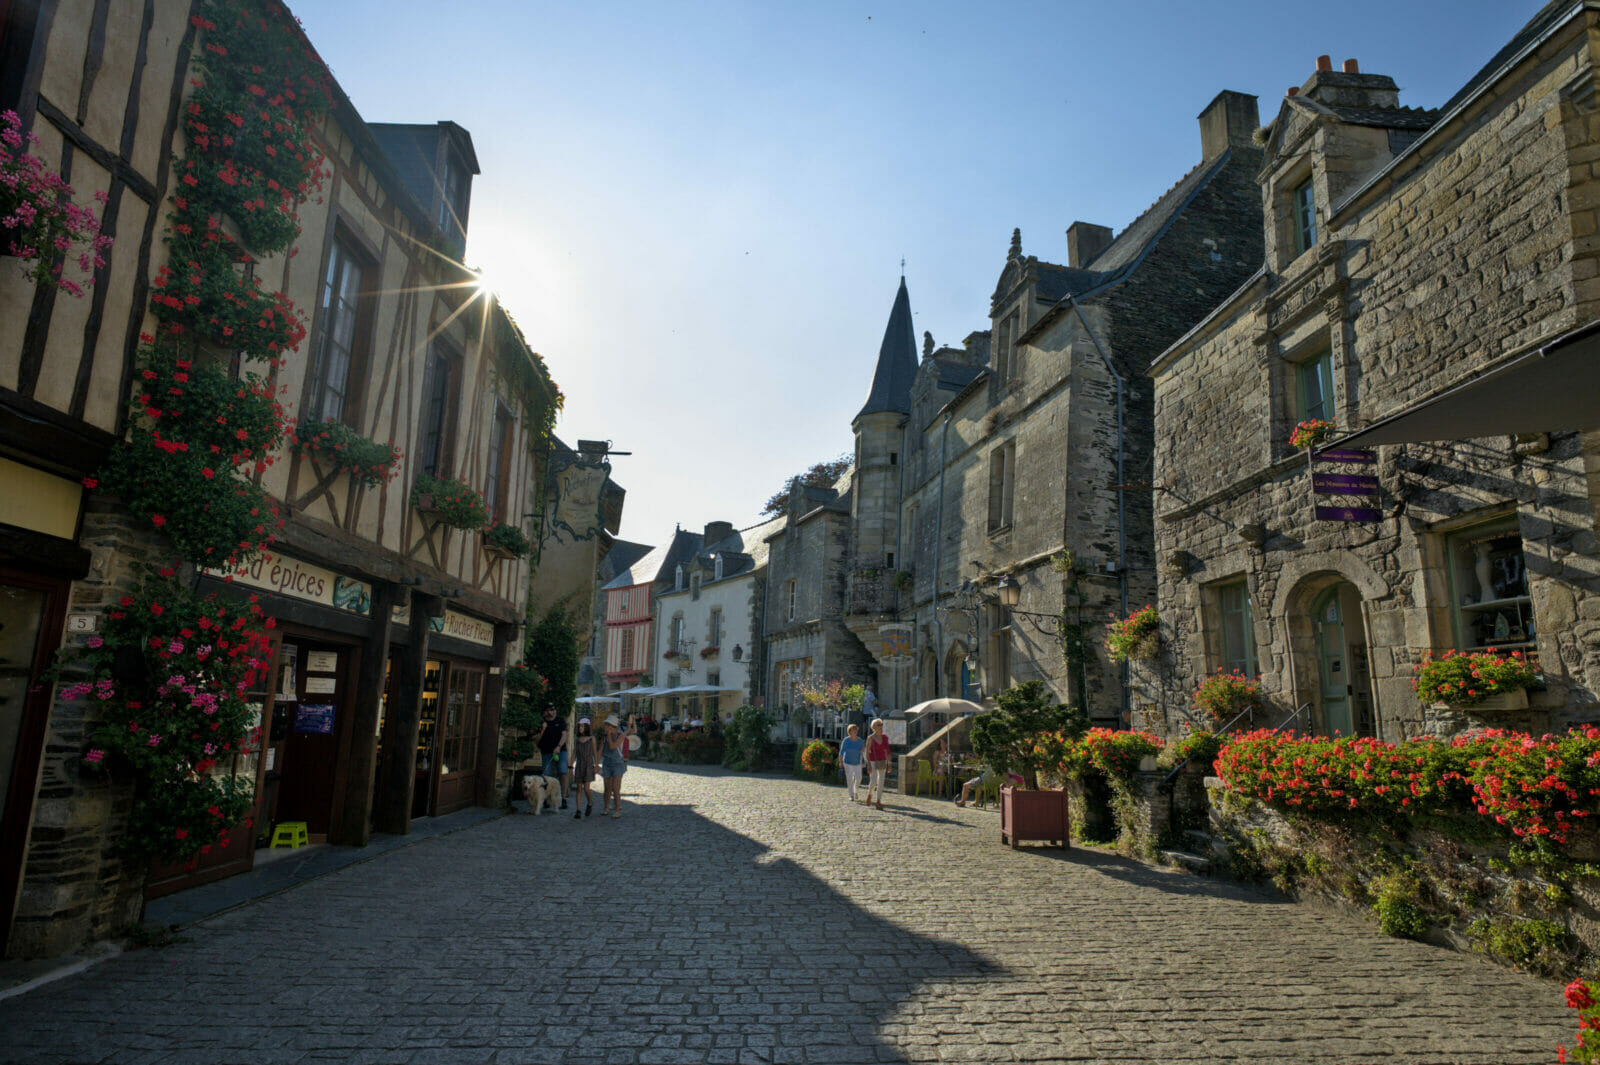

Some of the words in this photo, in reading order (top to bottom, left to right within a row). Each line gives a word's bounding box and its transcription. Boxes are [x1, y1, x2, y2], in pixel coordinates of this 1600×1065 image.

[251, 553, 325, 597] d'épices
[77, 618, 87, 629] 5
[449, 615, 474, 638] Rucher
